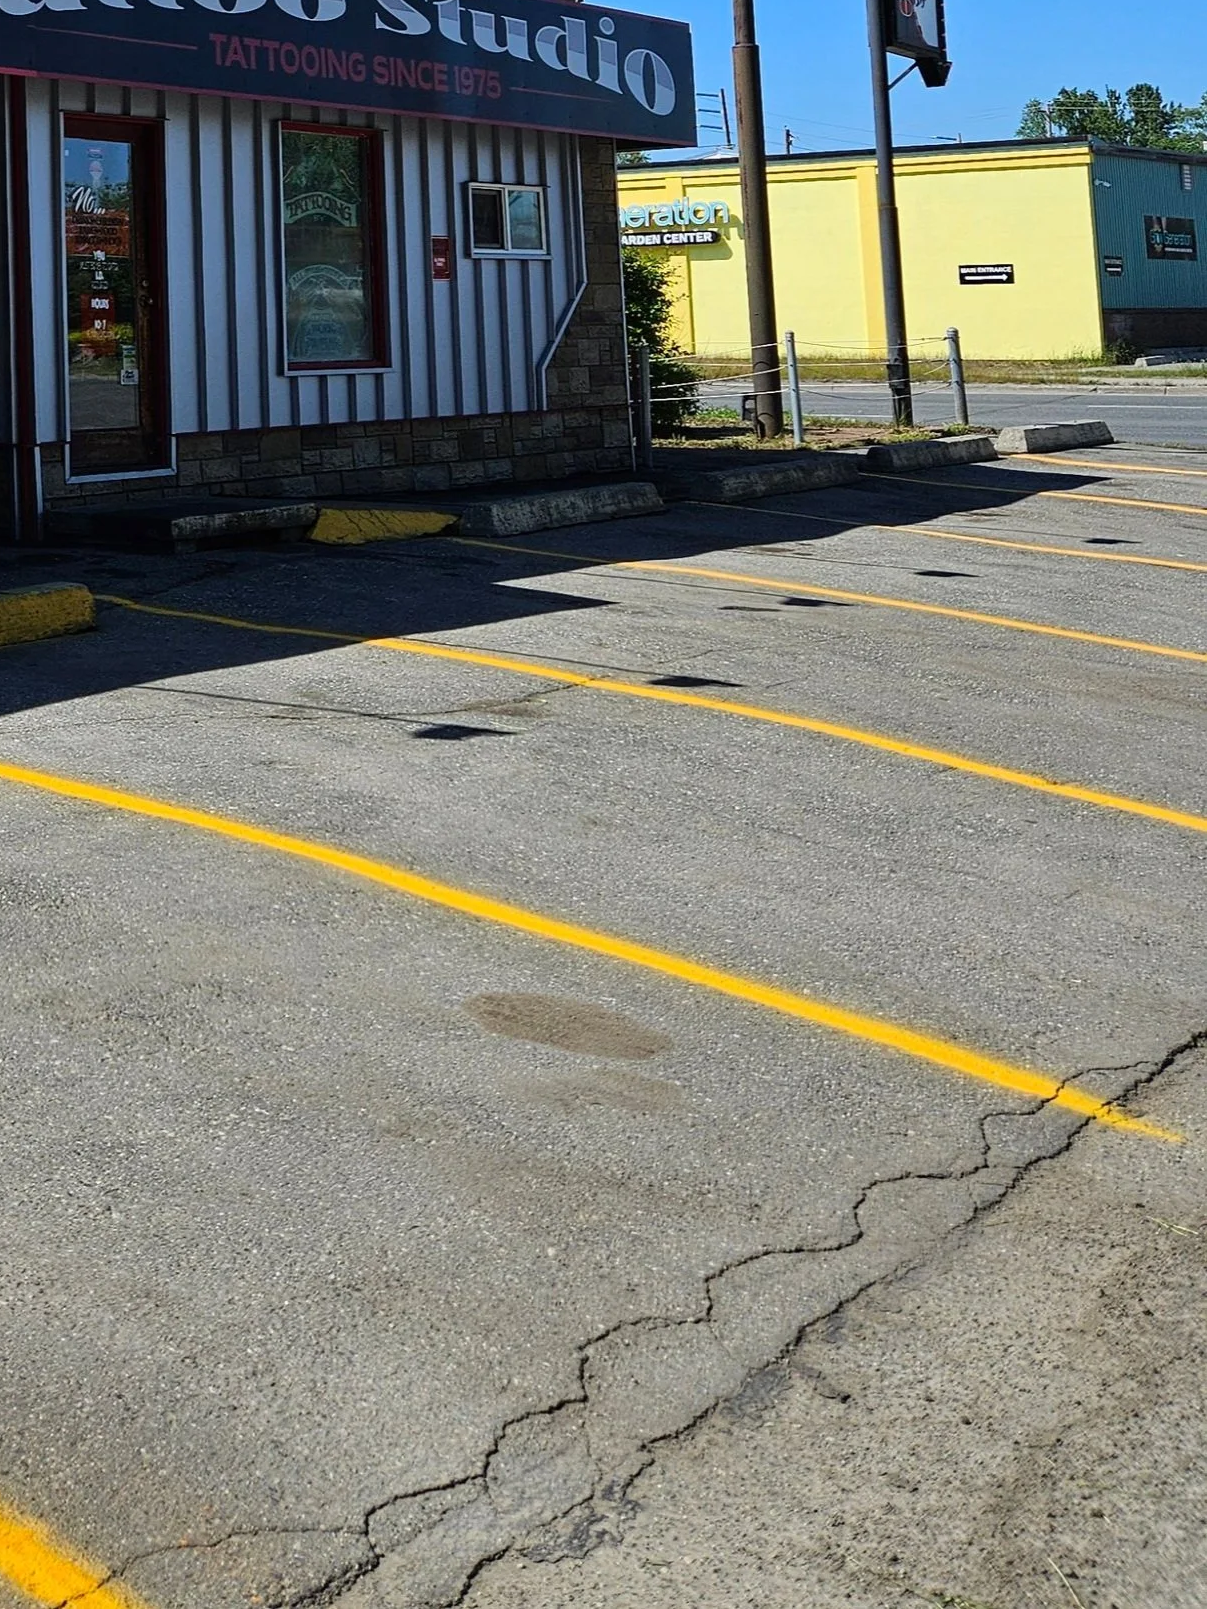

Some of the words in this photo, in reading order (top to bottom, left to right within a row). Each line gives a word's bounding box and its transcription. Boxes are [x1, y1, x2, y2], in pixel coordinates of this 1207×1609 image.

[208, 33, 367, 83] TATTOOING
[372, 55, 449, 92] SINCE
[452, 66, 502, 98] 1975
[286, 194, 353, 221] TATTOOING
[663, 232, 713, 245] CENTER
